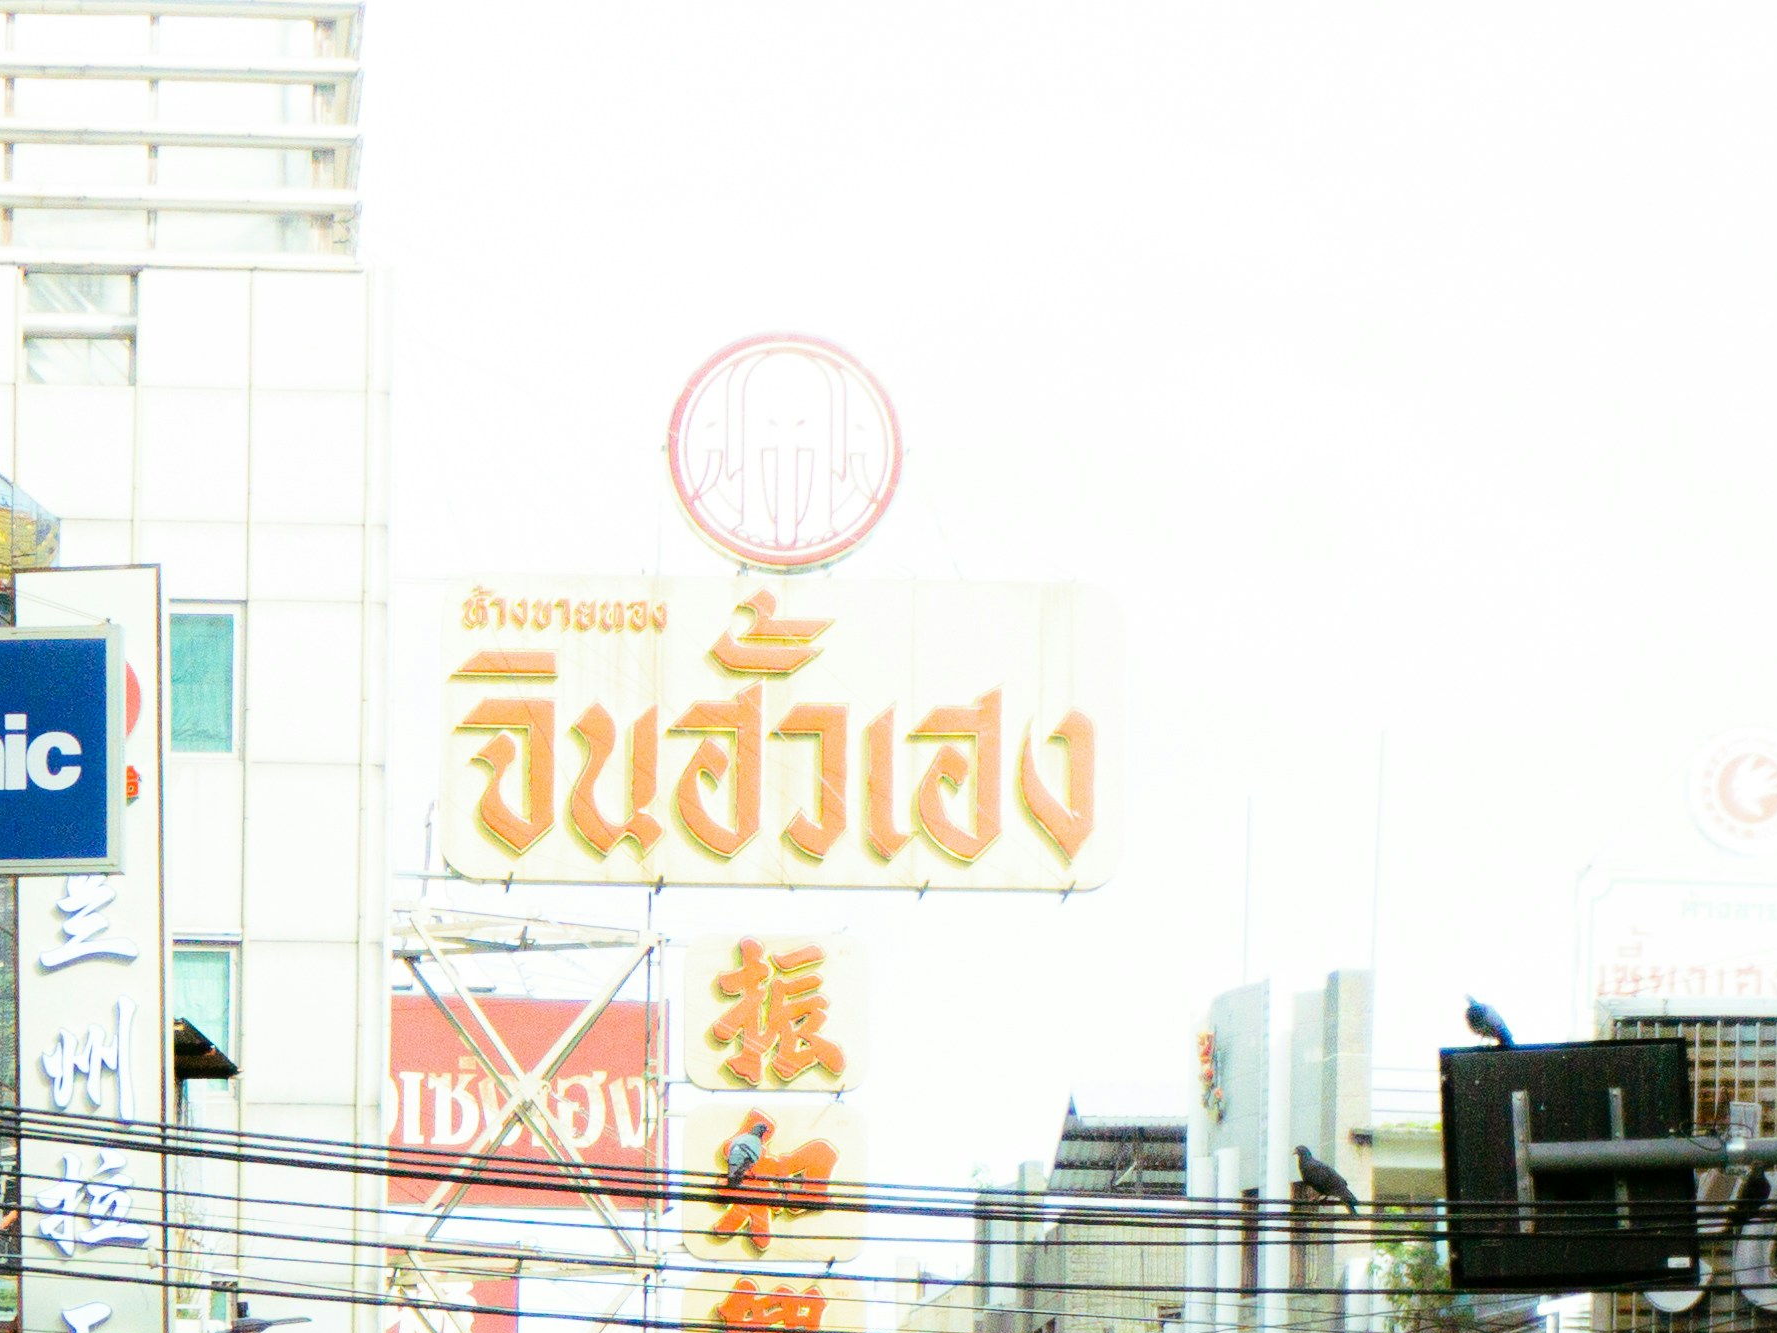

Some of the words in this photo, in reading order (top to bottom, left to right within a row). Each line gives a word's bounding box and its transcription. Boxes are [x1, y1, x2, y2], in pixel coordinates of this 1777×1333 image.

[462, 586, 668, 632] ห้างขายทอง
[449, 588, 1097, 863] จินฮั้วเฮง
